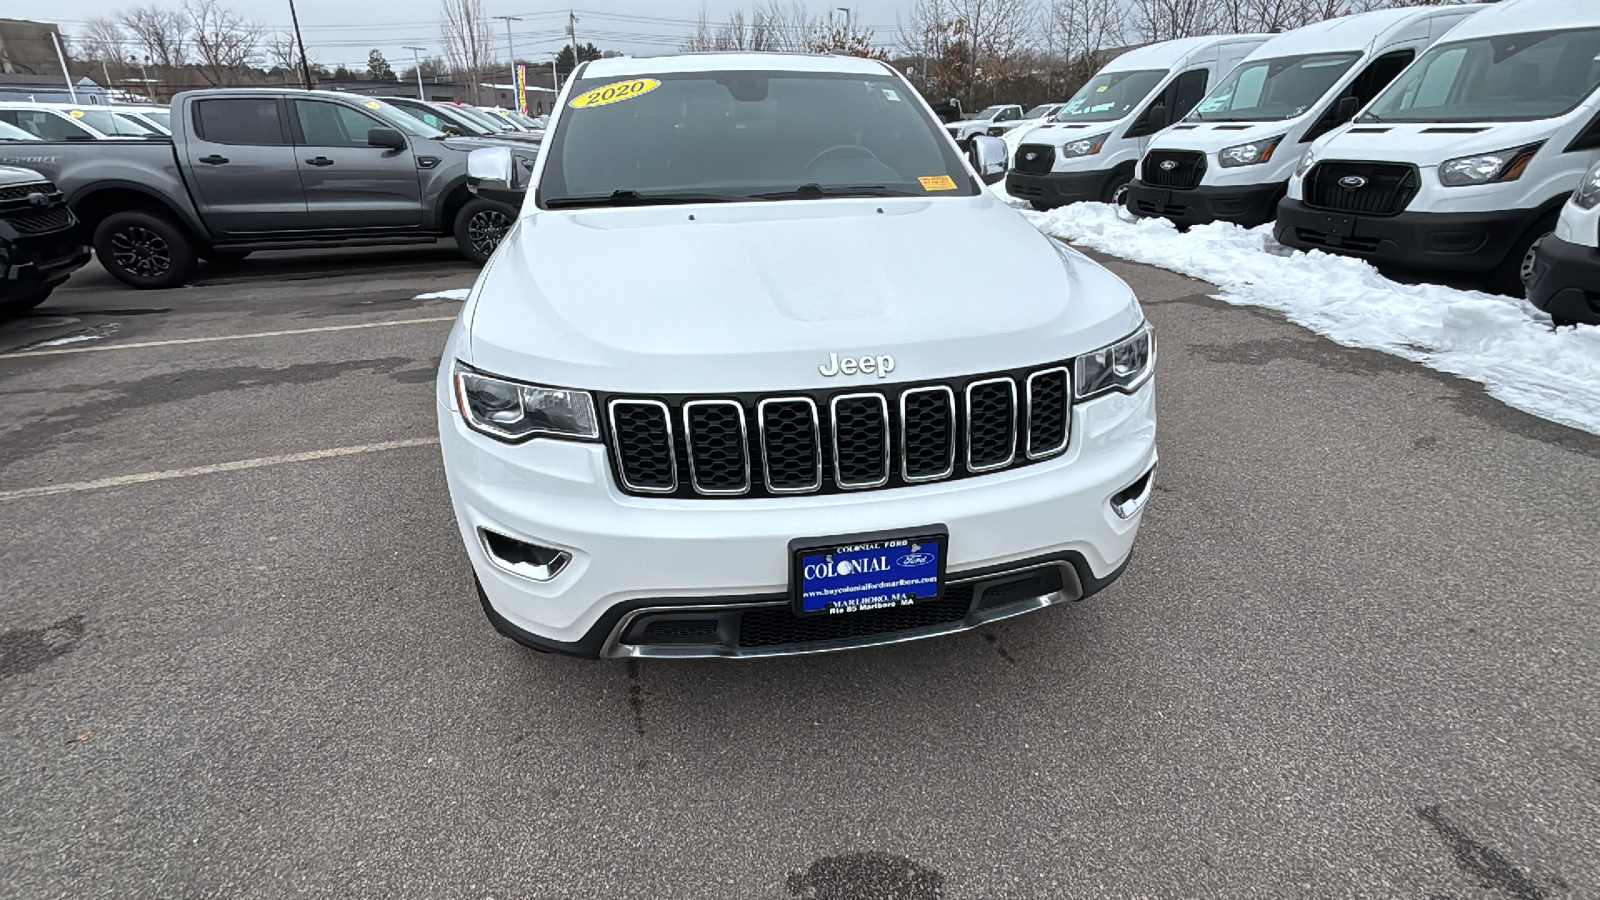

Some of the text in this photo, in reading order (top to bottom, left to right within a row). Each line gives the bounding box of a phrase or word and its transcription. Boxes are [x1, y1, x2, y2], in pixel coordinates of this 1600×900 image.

[586, 81, 645, 106] 2020
[819, 352, 895, 378] Jeep
[837, 540, 908, 553] COLONIAL FORD
[804, 556, 891, 580] COLONIAL
[902, 554, 928, 565] Ford
[803, 576, 937, 598] www.buycolonialfordmarlboro.com
[891, 592, 907, 600] MA
[859, 602, 896, 611] Marlboro
